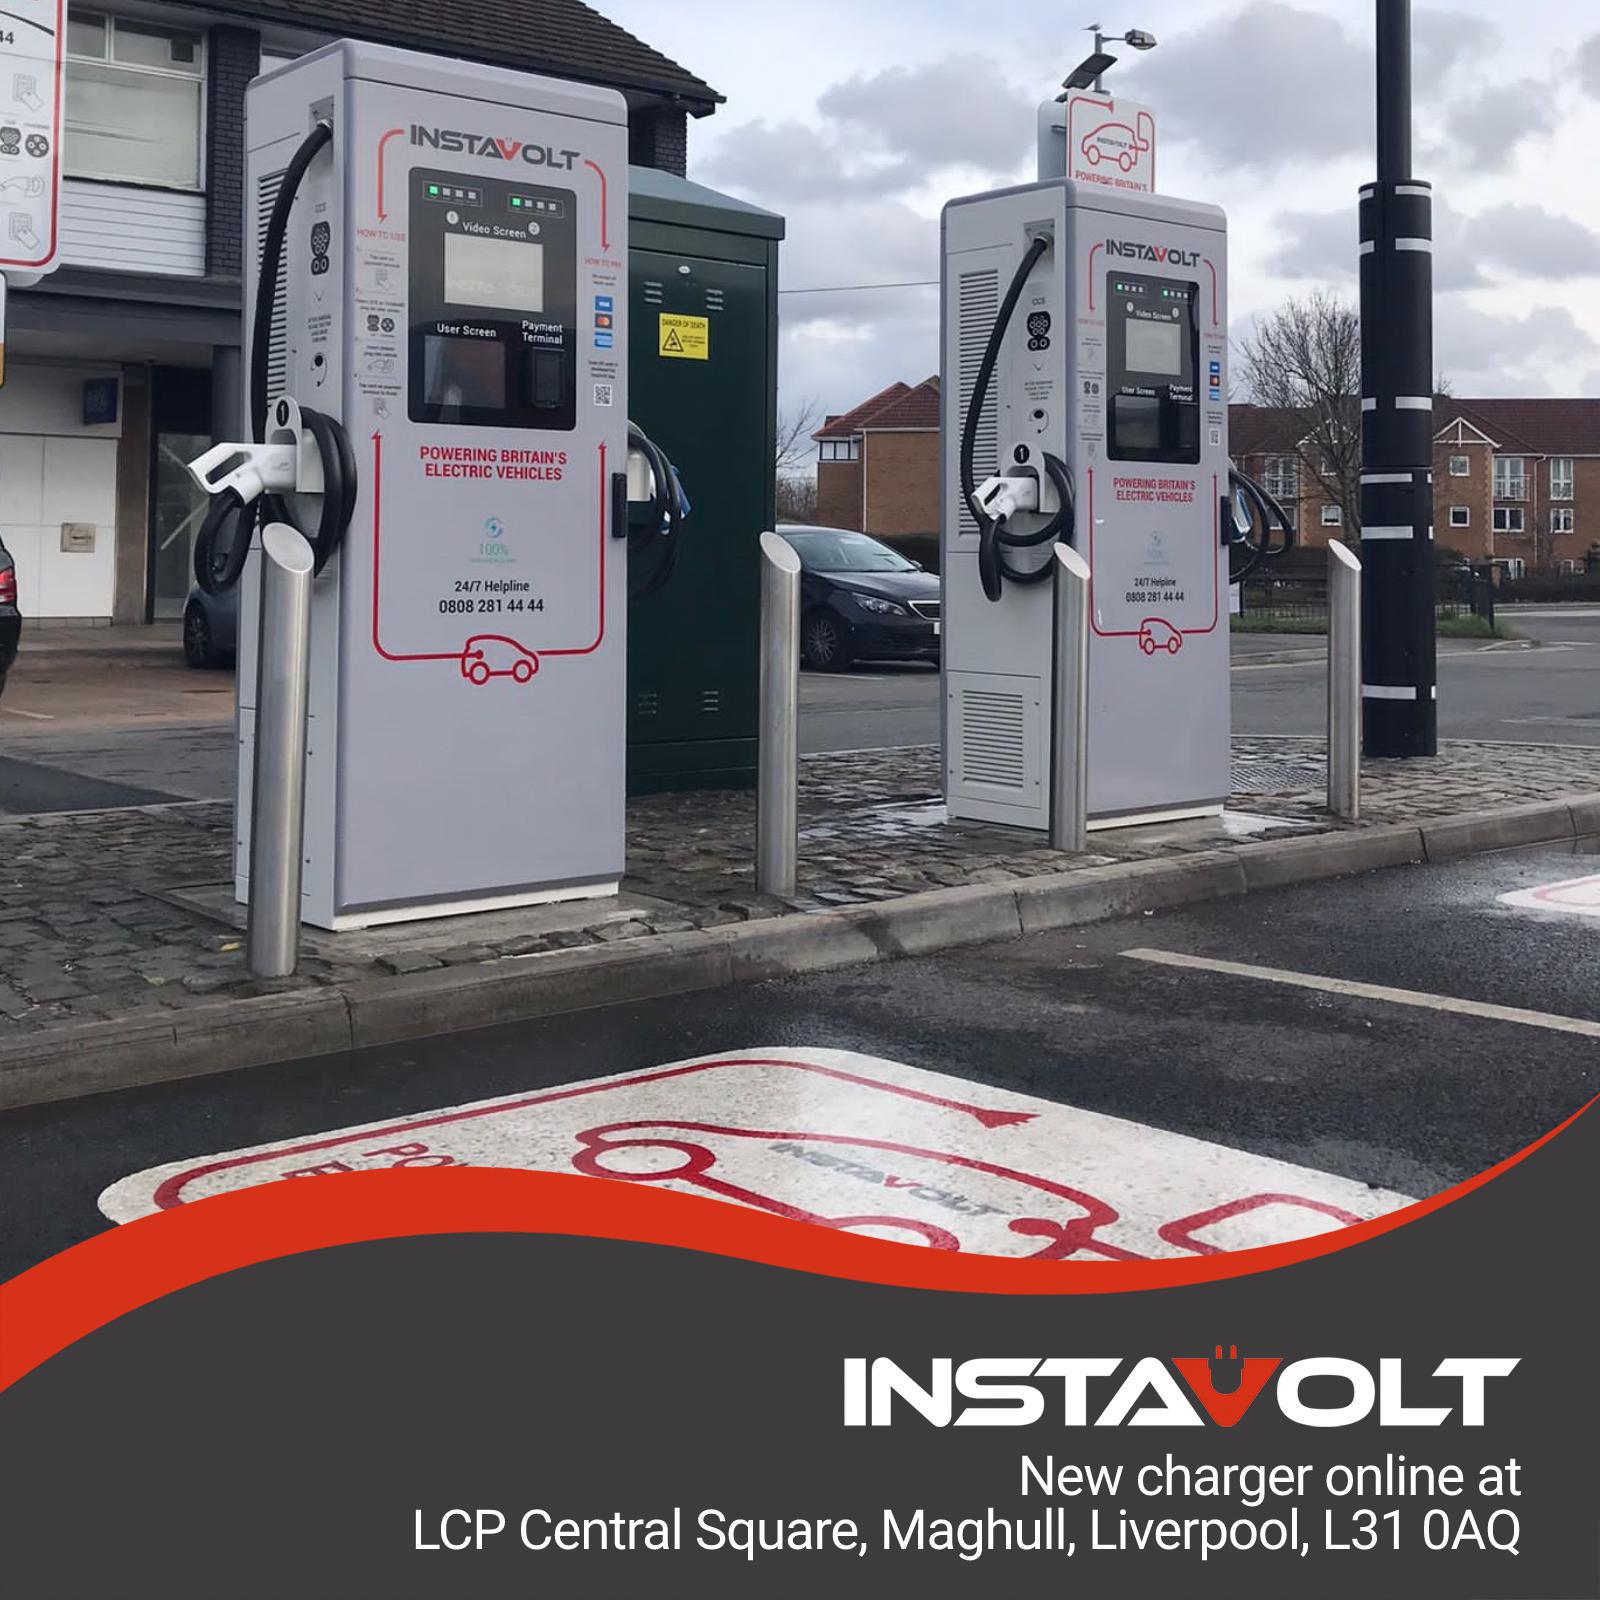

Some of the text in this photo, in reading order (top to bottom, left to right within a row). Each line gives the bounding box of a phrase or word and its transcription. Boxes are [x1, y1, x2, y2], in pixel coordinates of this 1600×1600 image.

[410, 124, 580, 171] INSTAVOLT
[462, 221, 527, 239] Video Screen
[1106, 239, 1200, 268] INSTAVOLT
[437, 323, 497, 337] User Screen
[522, 320, 563, 334] Payment
[522, 332, 563, 345] Terminal
[420, 446, 567, 465] POWERING BRITAIN'S
[425, 463, 562, 480] ELECTRIC VEHICLES
[1113, 477, 1196, 491] POWERING BRITAIN'S
[1116, 490, 1193, 502] ELECTRIC VEHICLES
[455, 580, 530, 594] 24/7 Helpline
[439, 599, 544, 613] 0808 281 44 44
